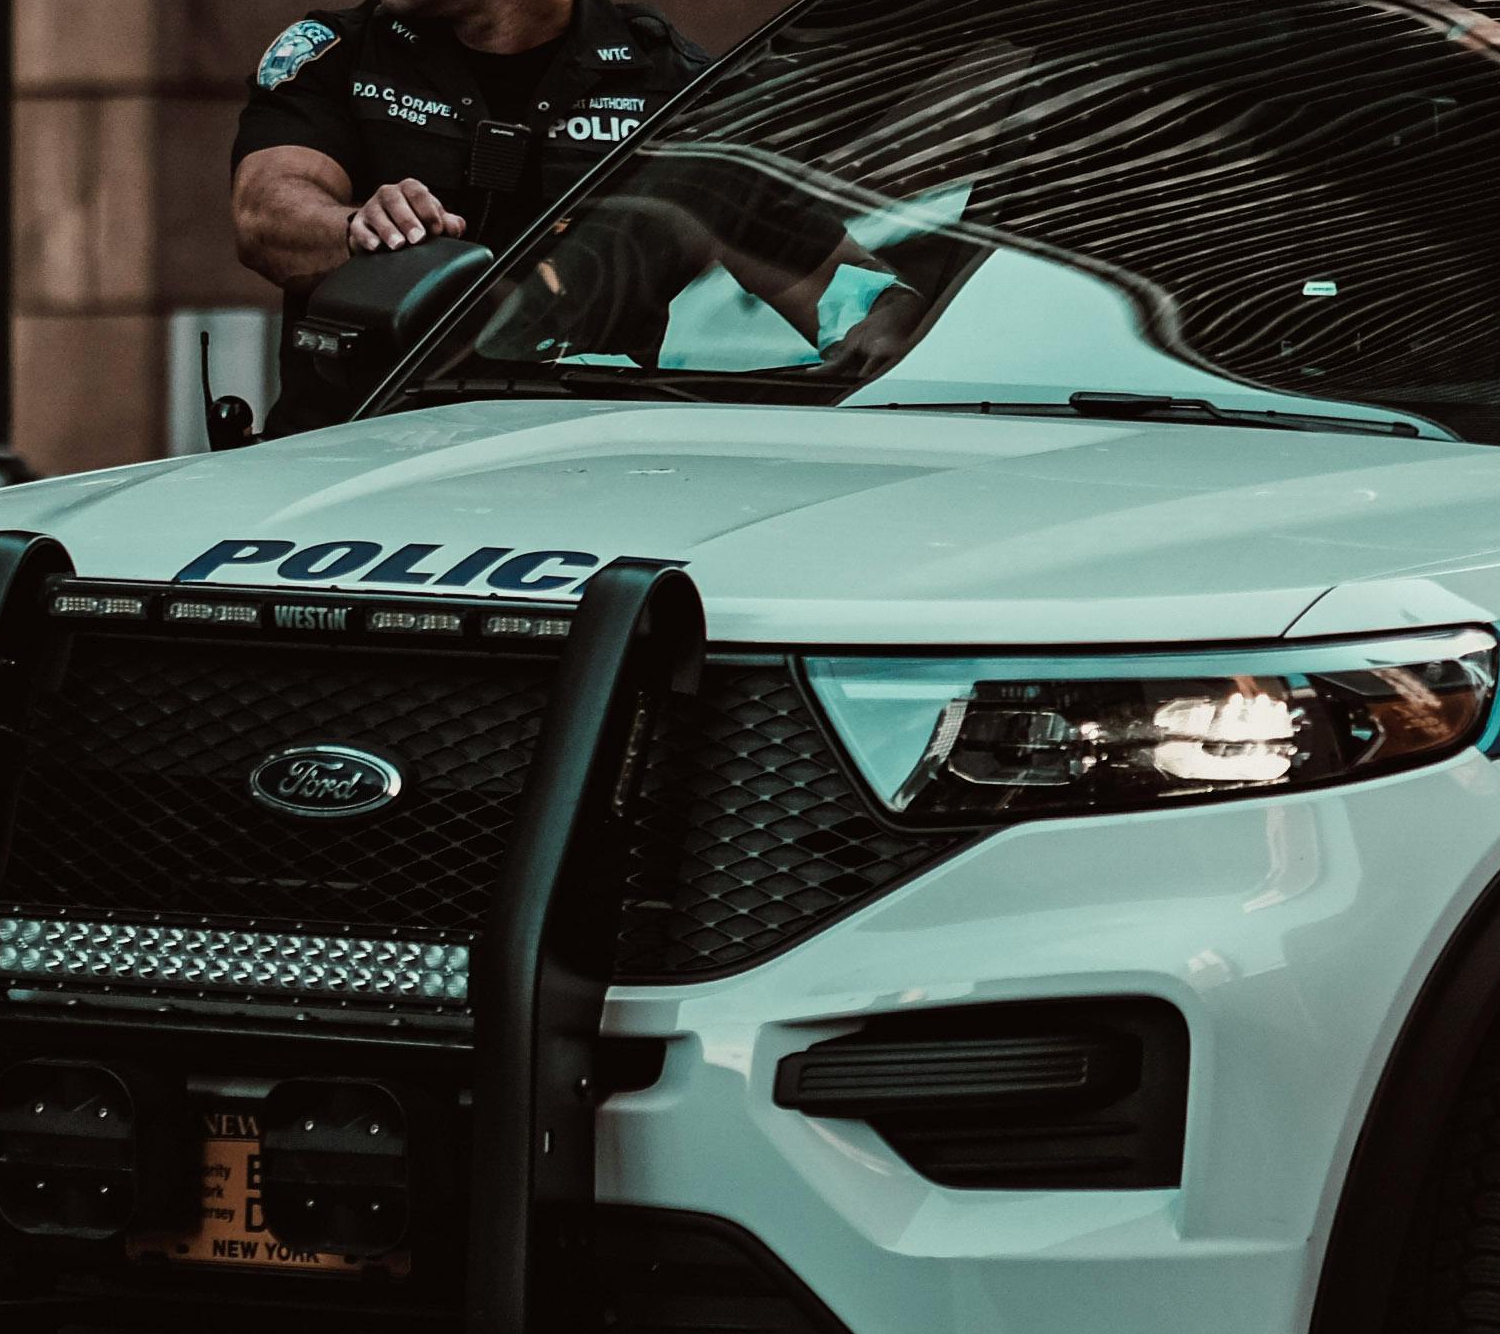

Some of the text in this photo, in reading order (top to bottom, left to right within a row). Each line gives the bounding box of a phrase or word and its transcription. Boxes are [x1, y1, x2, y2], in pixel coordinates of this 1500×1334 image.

[597, 47, 632, 61] WTC
[352, 82, 380, 99] P.O.
[588, 96, 645, 113] AUTHORITY
[387, 103, 428, 126] 3495
[278, 759, 362, 799] Ford
[212, 1239, 259, 1260] NEW
